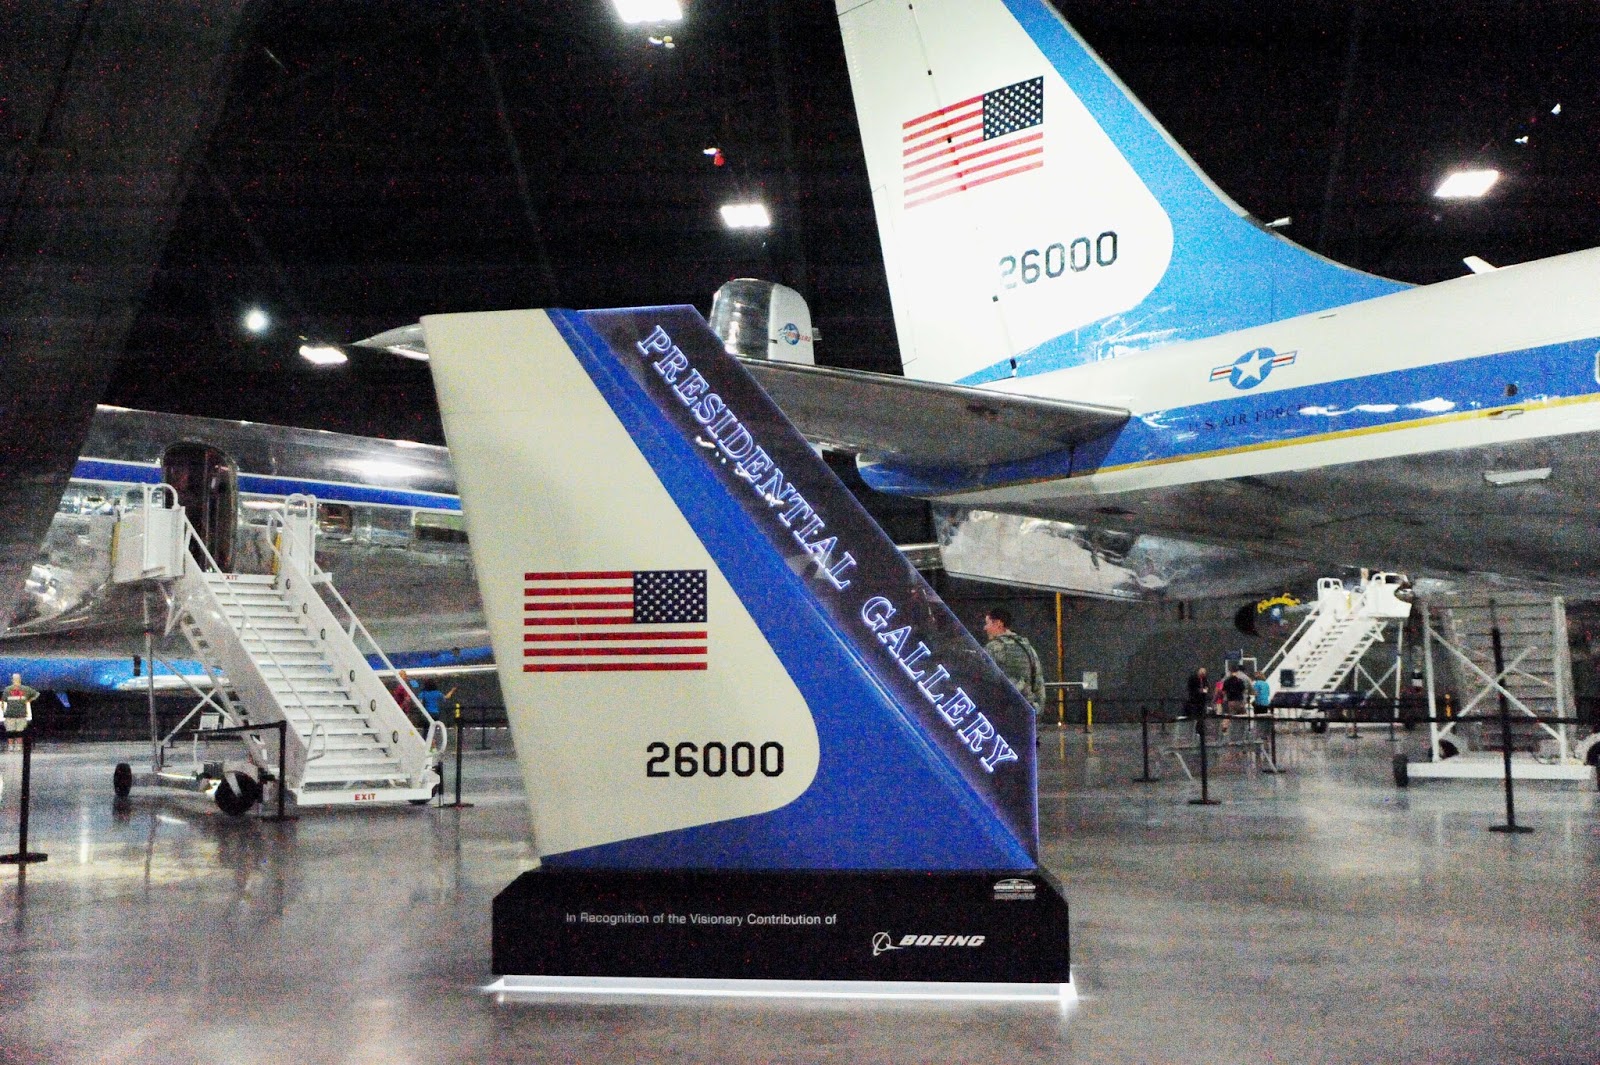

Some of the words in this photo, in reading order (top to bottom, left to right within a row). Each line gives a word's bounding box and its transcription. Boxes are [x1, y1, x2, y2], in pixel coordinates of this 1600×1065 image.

[998, 230, 1118, 289] 26000
[637, 325, 857, 591] PRESIDENTIAL
[862, 596, 1019, 773] GALLERY
[646, 741, 784, 776] 26000
[354, 792, 376, 801] EXIT
[566, 912, 577, 923] In
[580, 911, 650, 926] Recognition
[653, 912, 665, 924] of
[668, 913, 687, 924] the
[690, 913, 743, 926] Visionary
[747, 913, 821, 925] Contribution
[825, 913, 838, 925] of
[899, 934, 986, 947] BOEING
